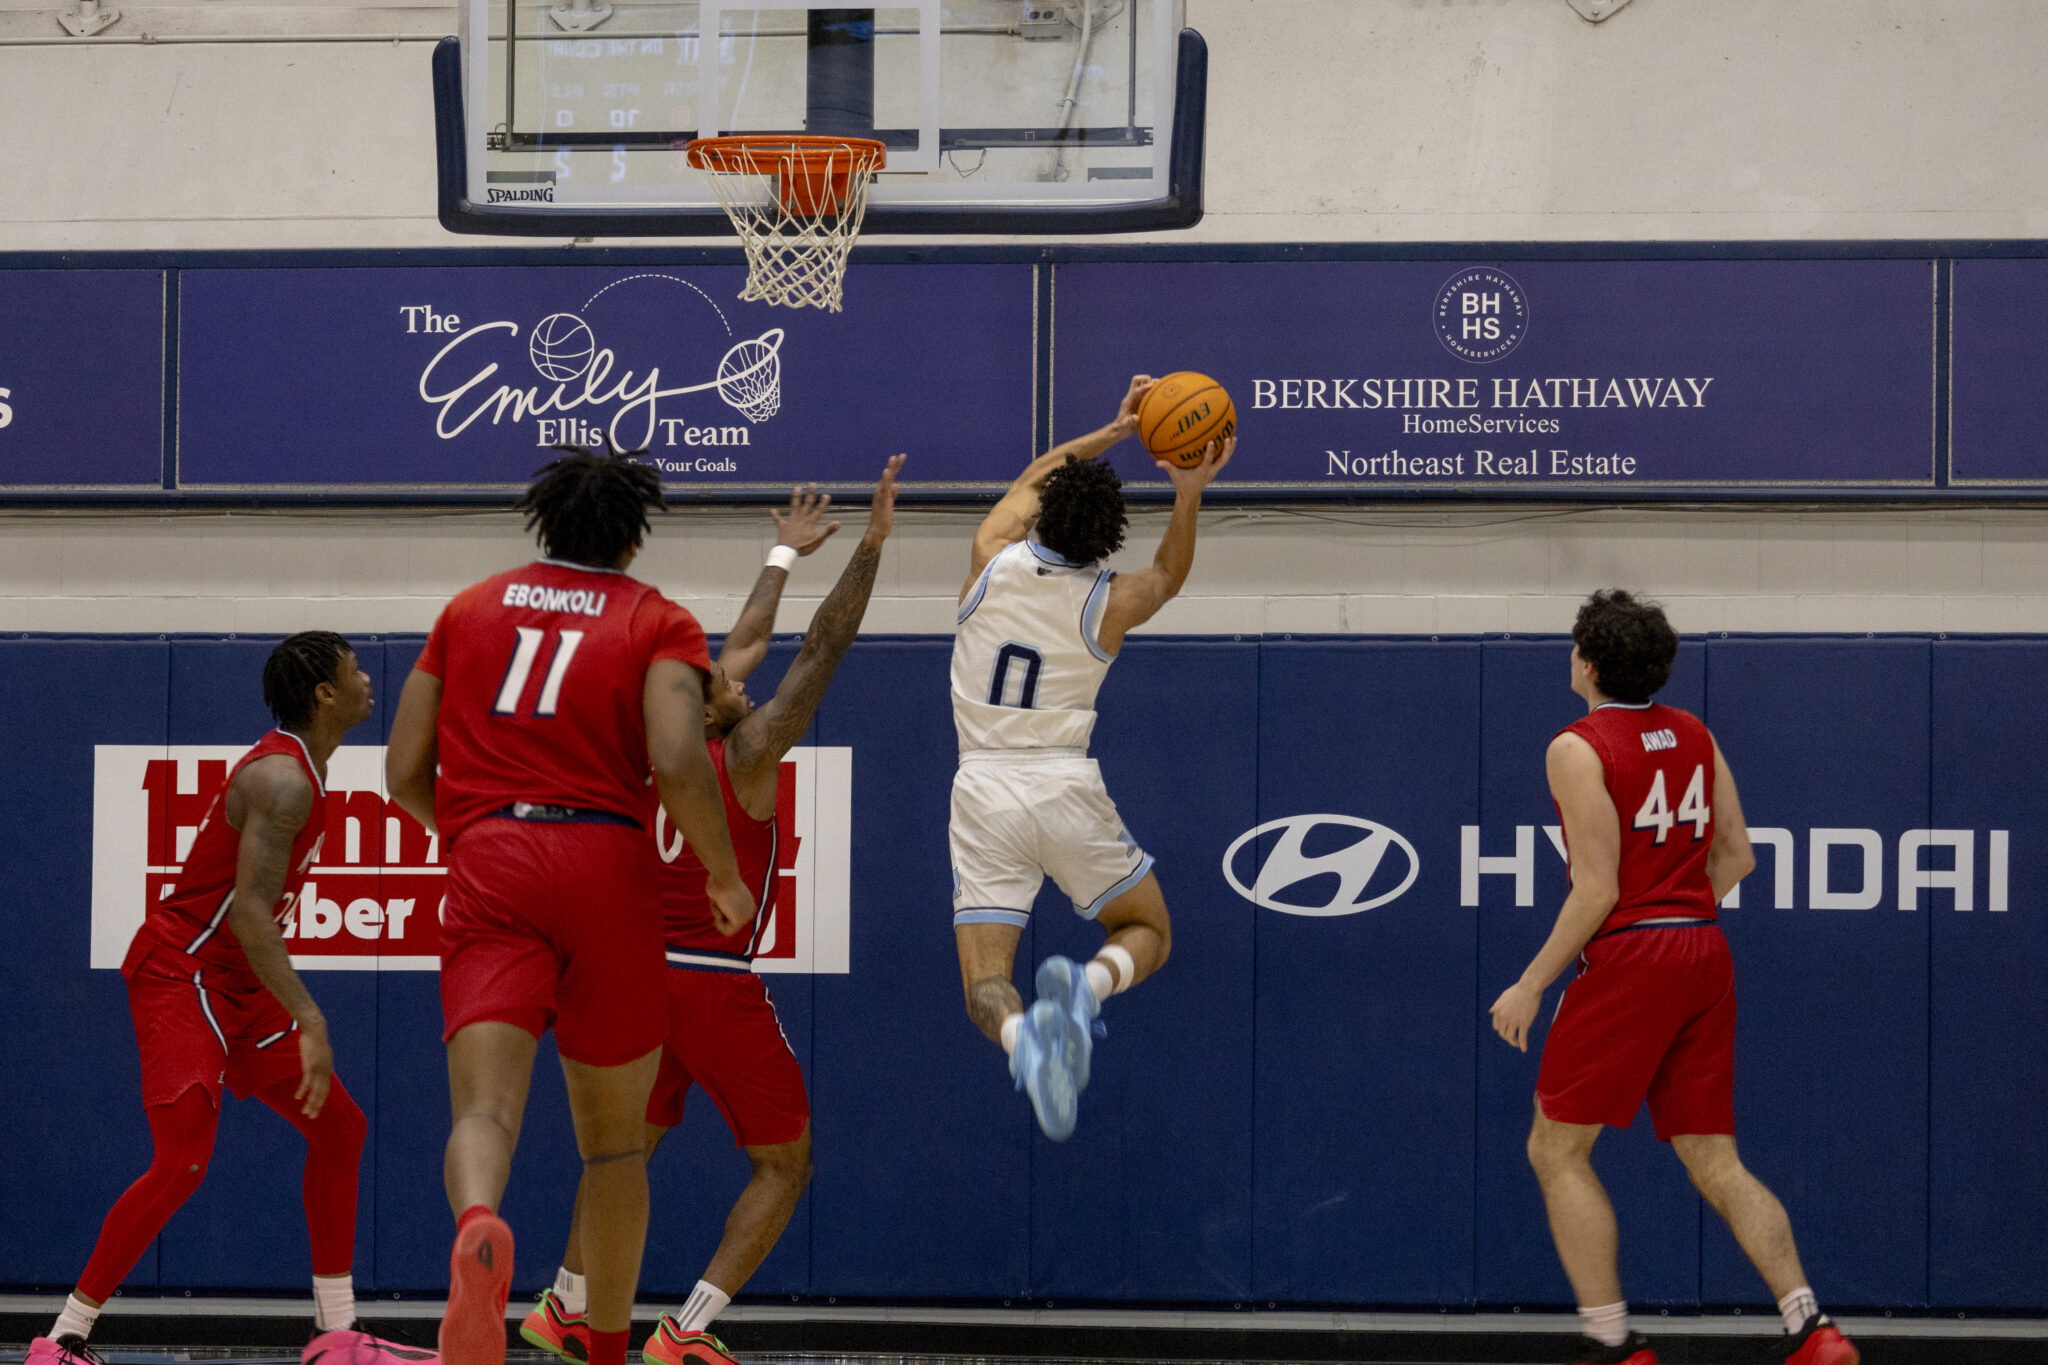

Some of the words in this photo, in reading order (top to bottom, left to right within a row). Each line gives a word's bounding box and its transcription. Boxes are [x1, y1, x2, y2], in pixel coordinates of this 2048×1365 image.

[487, 187, 553, 204] SPALDING
[1439, 274, 1480, 317] BERKSHIRE
[1485, 274, 1523, 317] HATHAWAY
[1462, 292, 1500, 315] BH
[400, 305, 461, 334] The
[1462, 316, 1501, 340] HS
[419, 321, 662, 453] Emily
[1252, 378, 1480, 409] BERKSHIRE
[1490, 377, 1714, 408] HATHAWAY
[536, 418, 603, 447] Ellis
[659, 418, 750, 446] Team
[1403, 414, 1560, 434] HomeServices
[655, 458, 692, 472] Your
[694, 457, 737, 472] Goals
[1326, 450, 1465, 475] Northeast
[1475, 450, 1539, 475] Real
[1549, 450, 1636, 475] Estate
[502, 584, 607, 617] EBONKOLI
[489, 626, 585, 718] 11
[985, 640, 1046, 710] 0
[1640, 728, 1678, 753] AWAD
[1631, 763, 1711, 847] 44
[1460, 825, 2010, 912] HNDAI
